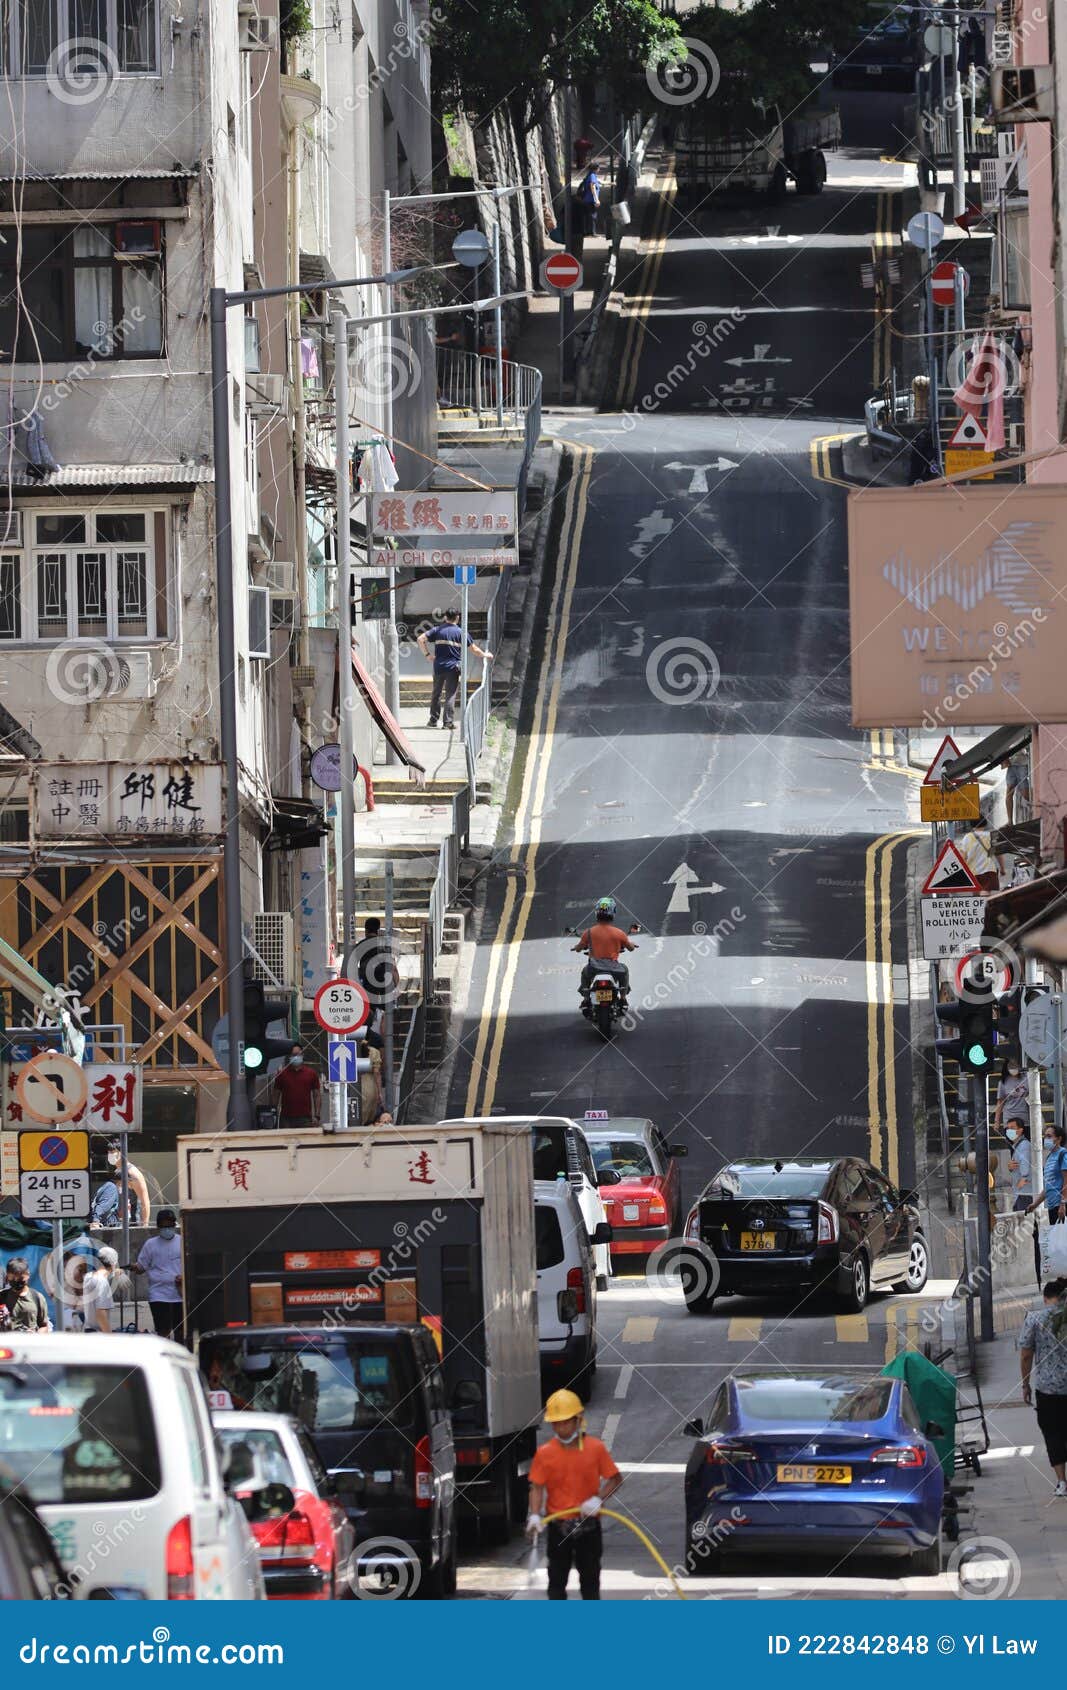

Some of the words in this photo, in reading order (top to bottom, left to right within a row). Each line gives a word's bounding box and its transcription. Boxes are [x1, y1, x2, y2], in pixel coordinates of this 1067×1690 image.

[376, 553, 396, 565] AH
[402, 552, 425, 565] CHI
[50, 779, 102, 798] 註冊
[120, 771, 201, 811] 邱健
[51, 803, 101, 826] 中醫
[116, 815, 205, 832] 骨傷科醫館
[943, 861, 960, 876] 1:5
[931, 900, 970, 909] BEWARE
[973, 899, 984, 907] OF
[939, 908, 978, 918] VEHICLE
[926, 918, 966, 927] ROLLING
[949, 929, 971, 940] 小心
[331, 990, 352, 1002] 5.5
[408, 1151, 436, 1184] 達
[28, 1176, 49, 1190] 24
[54, 1176, 81, 1189] hrs
[36, 1195, 75, 1213] 全日
[783, 1468, 803, 1479] PN
[807, 1467, 846, 1480] 5273
